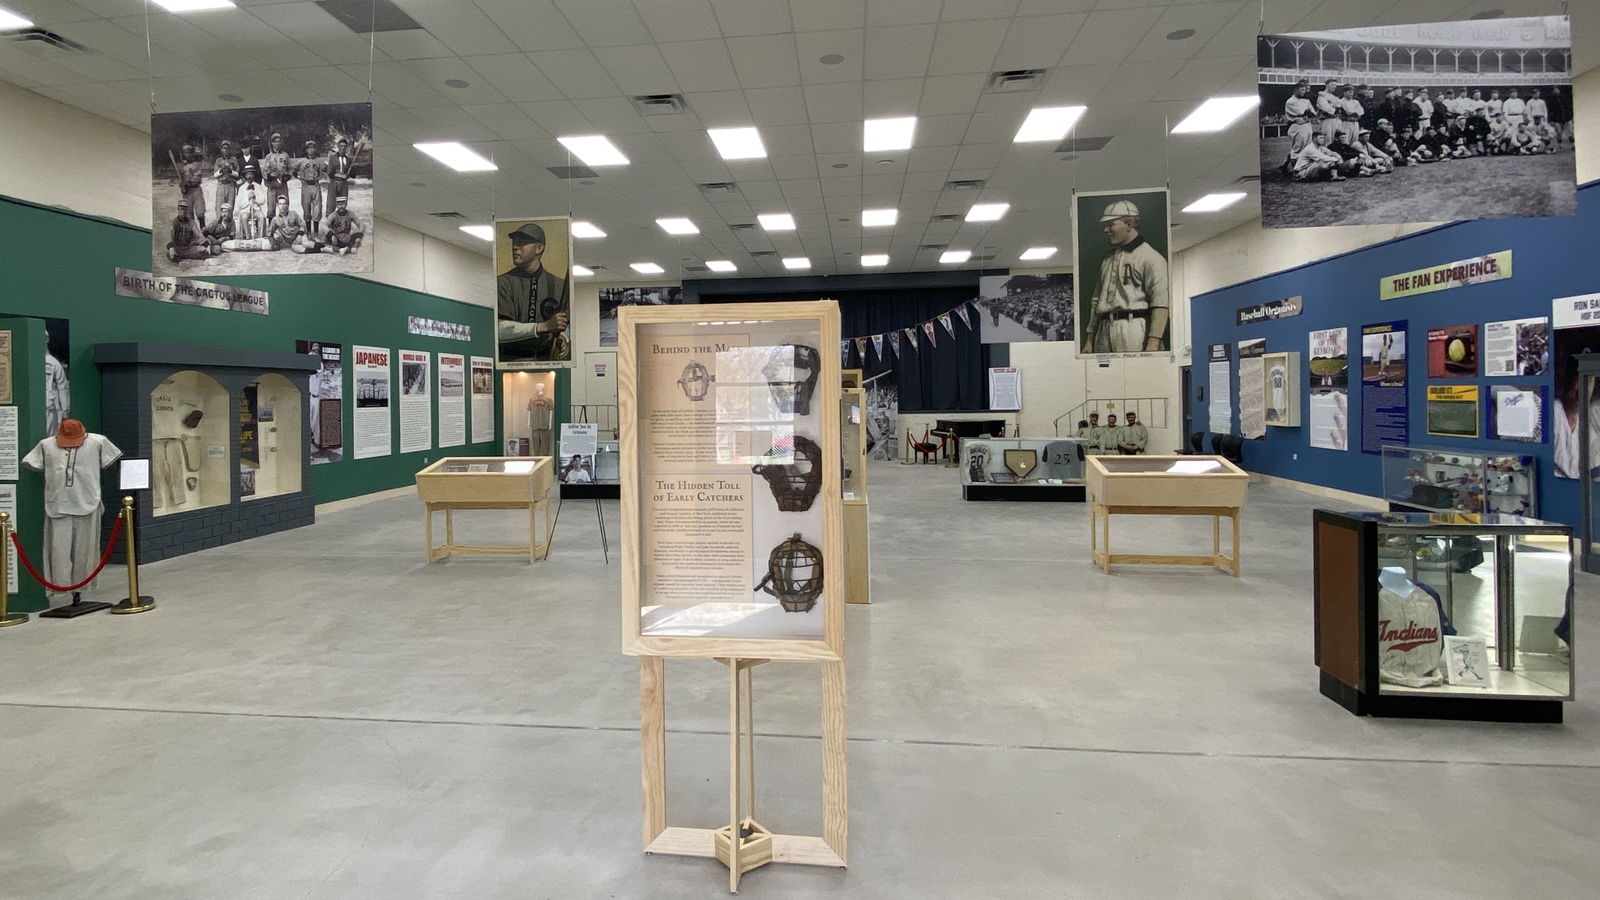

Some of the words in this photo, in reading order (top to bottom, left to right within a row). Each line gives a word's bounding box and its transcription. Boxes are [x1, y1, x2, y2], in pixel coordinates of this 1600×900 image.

[1393, 278, 1409, 292] THE
[1412, 273, 1431, 289] FAN
[1434, 259, 1497, 285] EXPERIENCE
[123, 276, 156, 290] BIRTH
[159, 281, 172, 293] OF
[175, 284, 194, 296] THE
[196, 287, 231, 301] CACTUS
[233, 293, 264, 306] LEAGUE
[1574, 300, 1588, 310] RON
[1241, 307, 1265, 321] Baseball
[1266, 302, 1297, 316] Organists
[1313, 331, 1328, 340] FIRST
[652, 344, 690, 354] BEHIND
[356, 352, 388, 366] JAPANESE
[970, 455, 984, 468] 20
[1053, 453, 1071, 465] 25
[655, 480, 676, 490] THE
[677, 480, 715, 490] HIDDEN
[716, 480, 741, 490] TOLL
[667, 492, 695, 502] EARLY
[697, 491, 744, 502] CATCHERS
[1378, 620, 1438, 642] Indians
